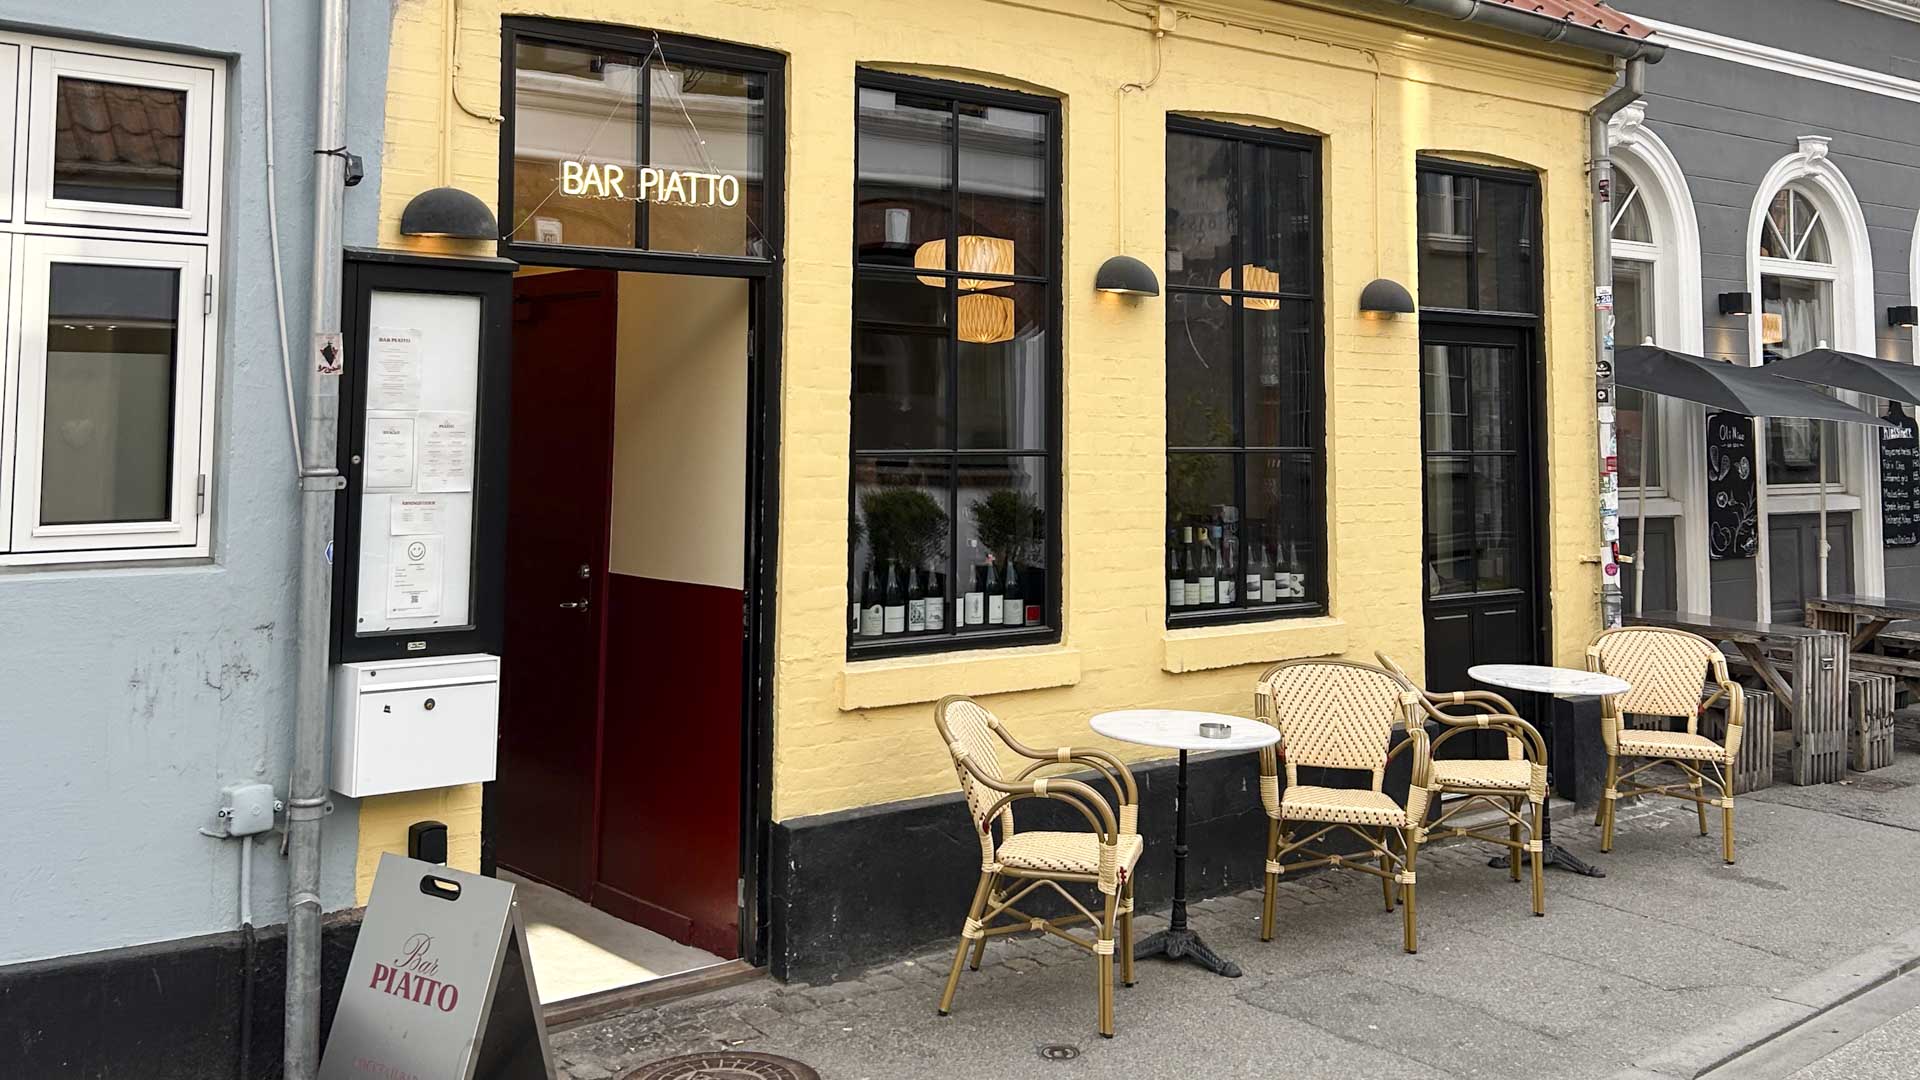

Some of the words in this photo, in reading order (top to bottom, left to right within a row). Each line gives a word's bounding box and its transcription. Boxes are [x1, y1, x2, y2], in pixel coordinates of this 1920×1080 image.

[561, 161, 624, 198] BAR
[638, 167, 740, 206] PIATTO
[393, 933, 440, 976] Bar
[369, 963, 459, 1013] PIATTO
